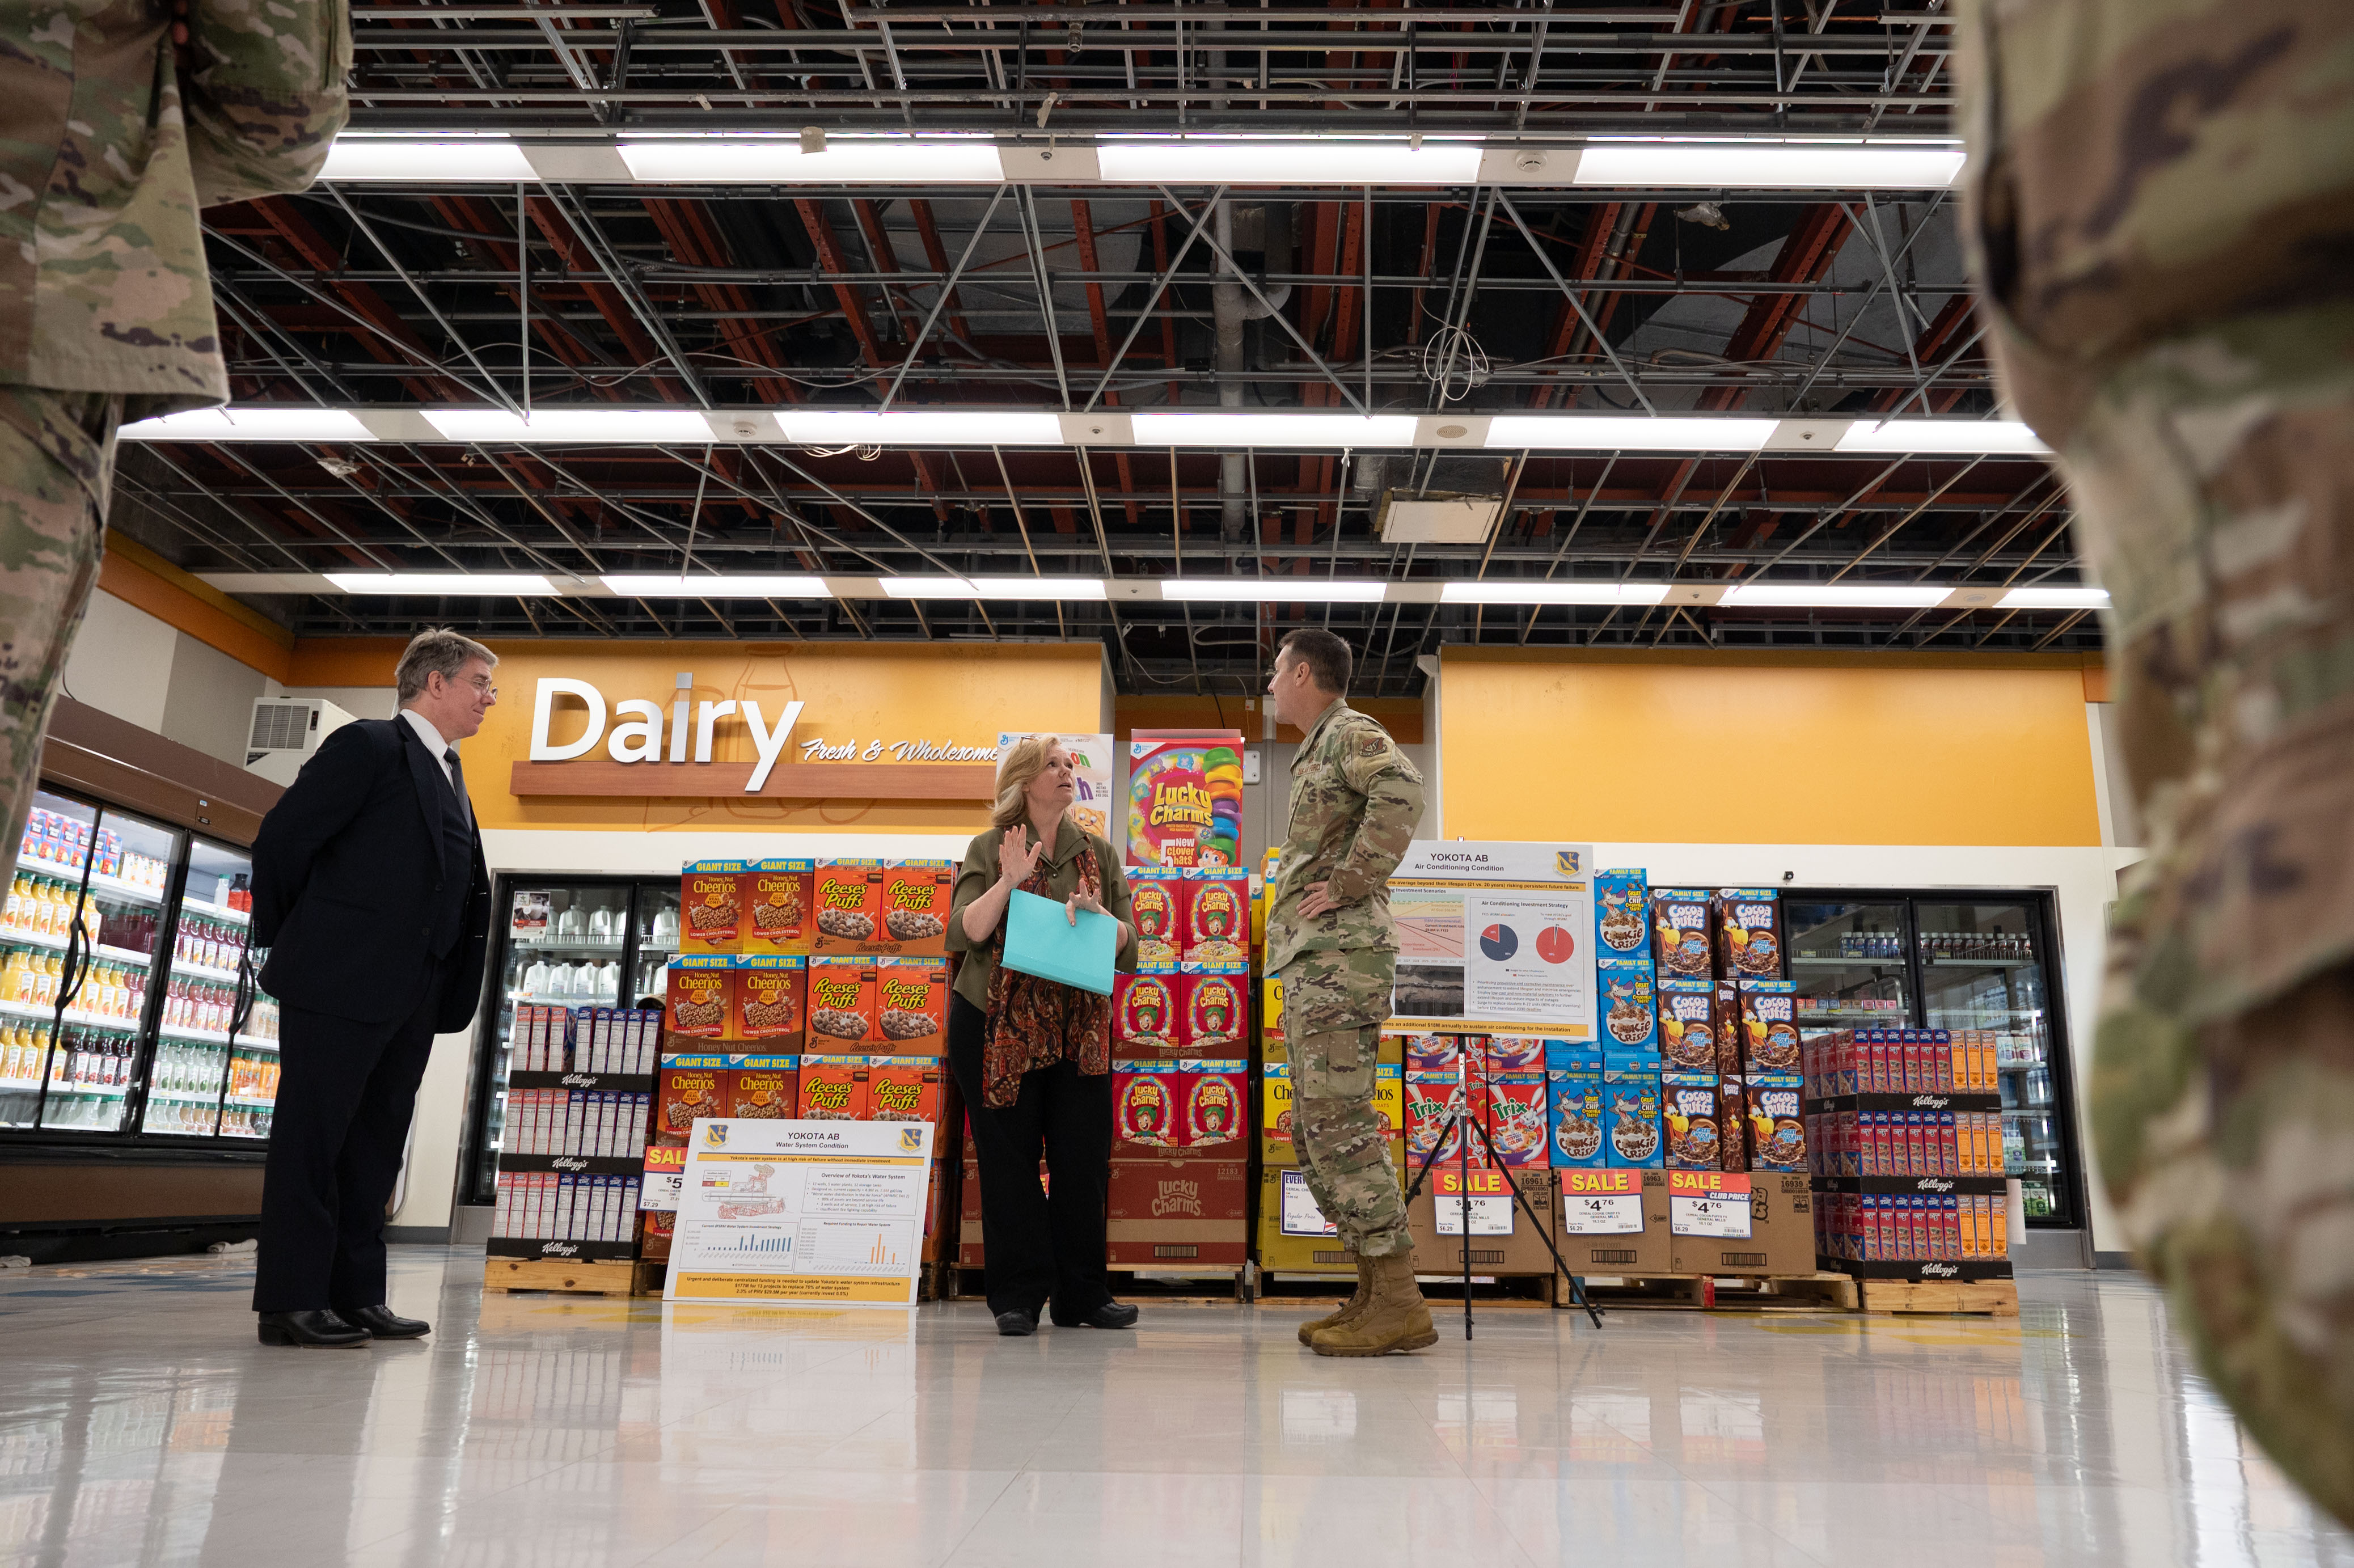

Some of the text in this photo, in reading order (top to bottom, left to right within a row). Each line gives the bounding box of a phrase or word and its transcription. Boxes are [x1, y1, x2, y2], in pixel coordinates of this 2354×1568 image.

[529, 672, 805, 792] Dairy
[800, 738, 858, 760] Fresh
[862, 739, 884, 761] &
[1153, 781, 1213, 814] Lucky
[1150, 805, 1214, 826] Charms
[1160, 838, 1194, 867] 5 New
[1167, 847, 1194, 856] Clover
[1174, 856, 1192, 865] hats
[696, 863, 741, 872] GIANT SIZE
[694, 880, 736, 893] Cheerios
[758, 879, 800, 891] Cheerios
[819, 878, 868, 894] Reese's
[889, 879, 936, 895] Reese's
[825, 893, 864, 909] Puffs
[893, 894, 933, 910] Puffs
[1139, 891, 1162, 902] Lucky
[1205, 891, 1228, 902] Lucky
[1135, 901, 1164, 912] Charms
[1201, 902, 1230, 912] Charms
[1668, 905, 1704, 917] Cocoa
[1736, 905, 1771, 917] Cocoa
[1611, 939, 1639, 949] Crisp
[1135, 986, 1159, 997] Lucky
[1203, 986, 1227, 997] Lucky
[1132, 996, 1161, 1007] Charms
[1200, 996, 1228, 1007] Charms
[1672, 997, 1708, 1009] Cocoa
[1755, 997, 1791, 1009] Cocoa
[562, 1073, 597, 1087] Kellogg's
[1913, 1095, 1949, 1108] Kellogg's
[1408, 1097, 1444, 1120] Trix
[1491, 1097, 1528, 1121] Trix
[552, 1157, 589, 1170] Kellogg's
[649, 1149, 686, 1165] SAL
[1443, 1174, 1501, 1191] SALE
[1571, 1173, 1629, 1191] SALE
[1672, 1173, 1721, 1190] SALE
[1917, 1178, 1954, 1191] Kellogg's
[1158, 1180, 1198, 1199] Lucky
[1152, 1197, 1202, 1216] Charms
[542, 1242, 579, 1256] Kellogg's
[1921, 1263, 1959, 1277] Kellogg's
